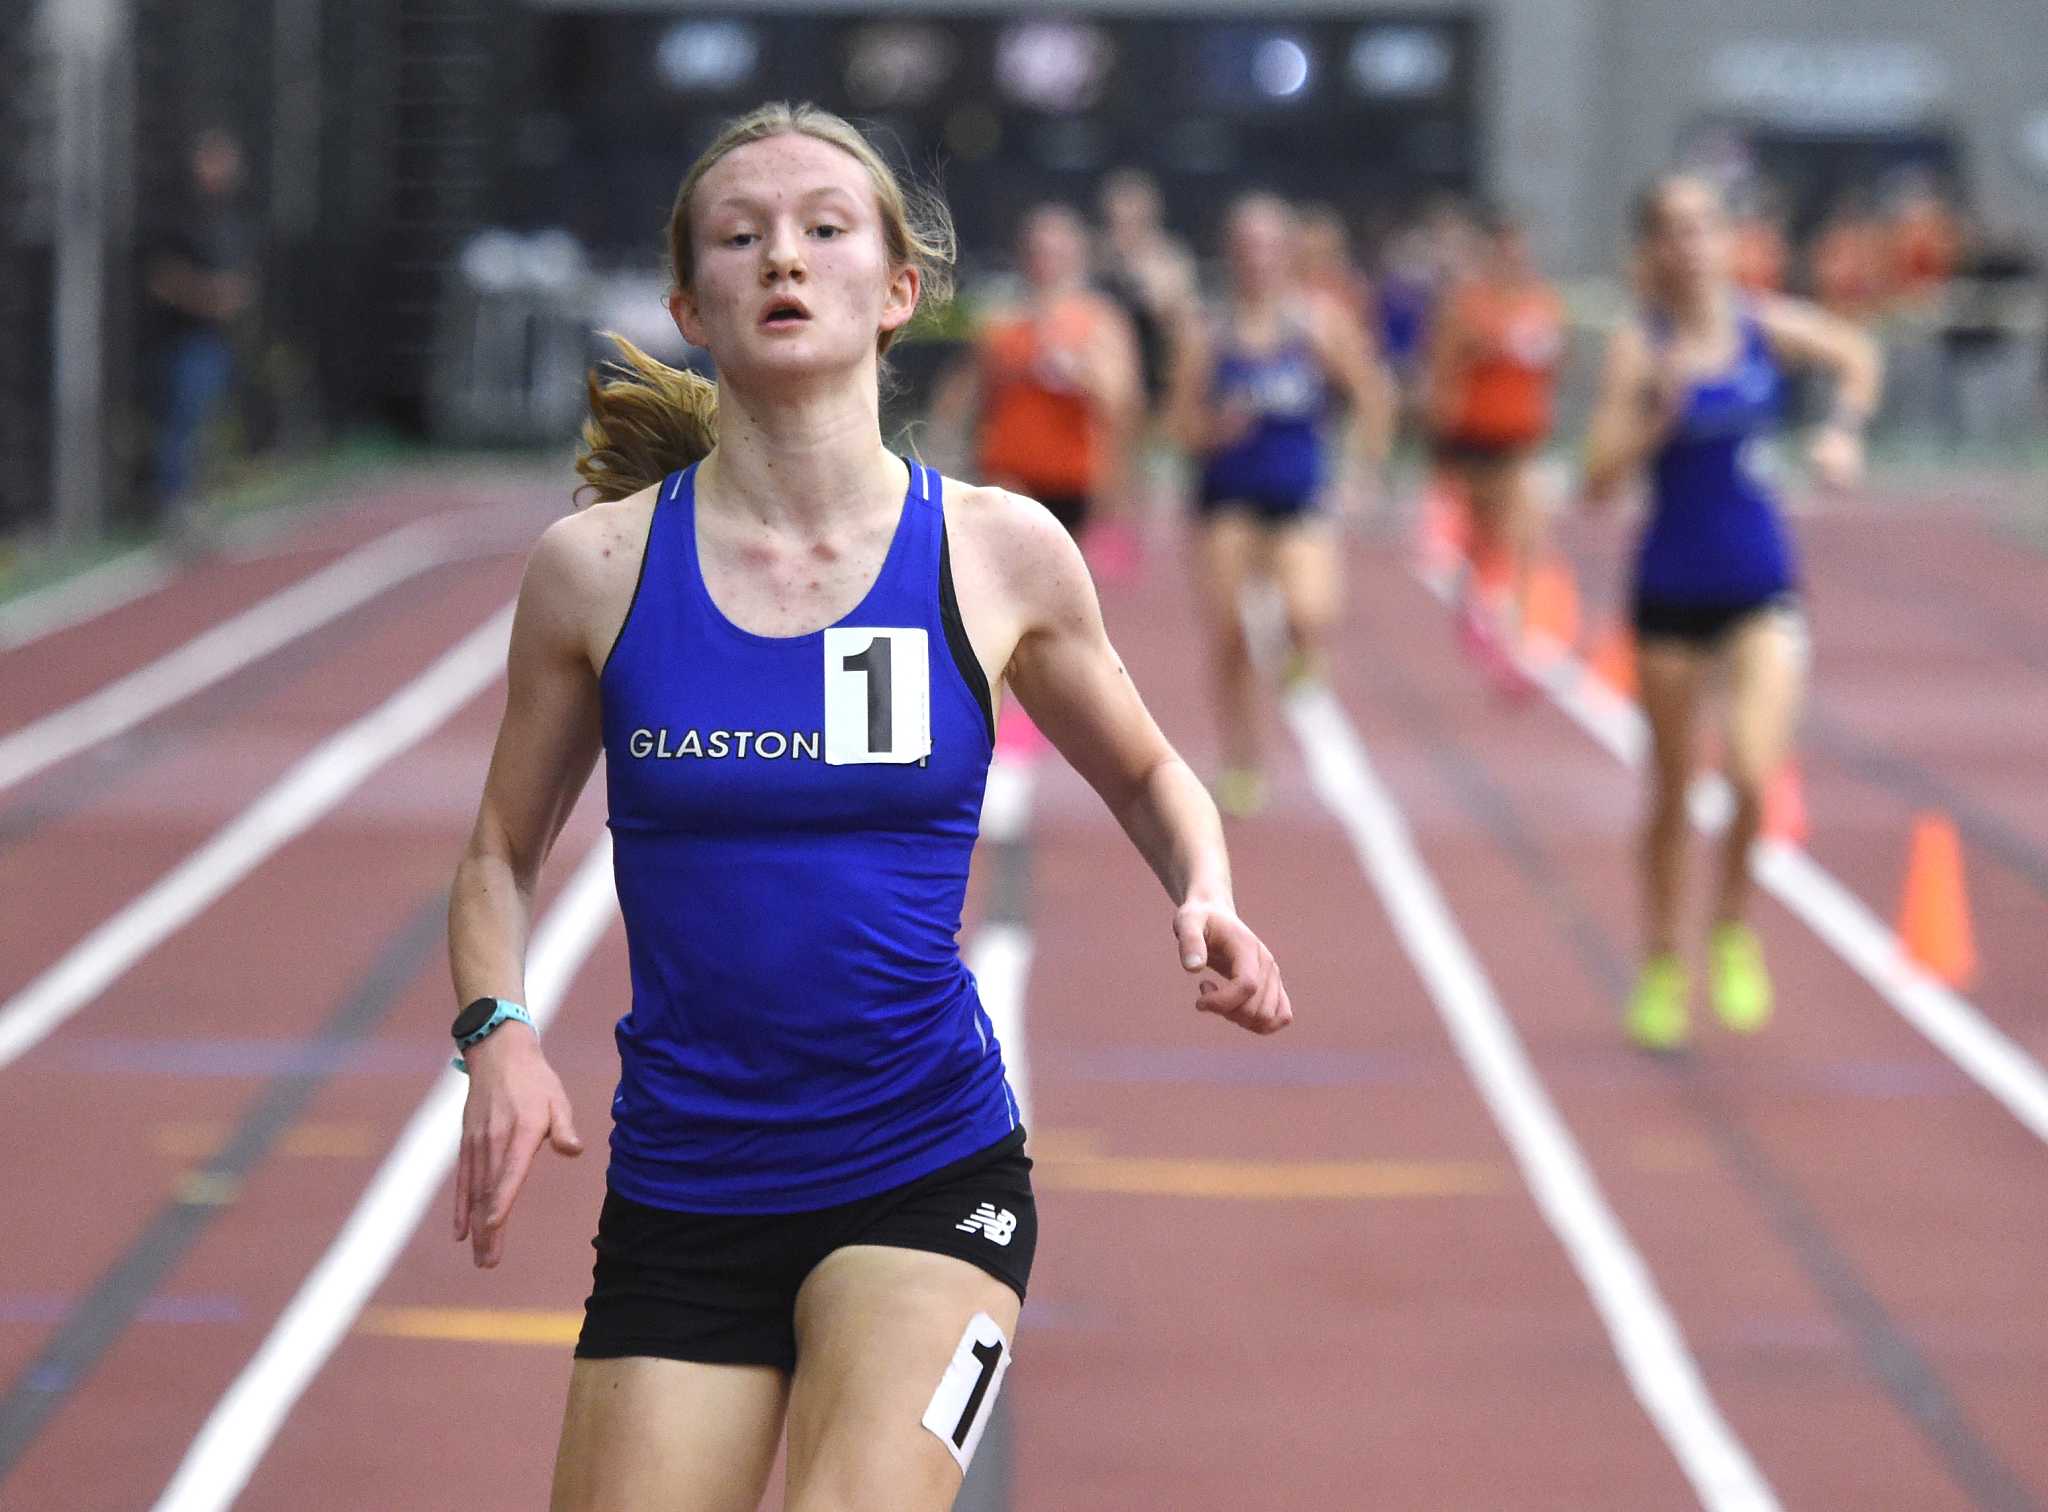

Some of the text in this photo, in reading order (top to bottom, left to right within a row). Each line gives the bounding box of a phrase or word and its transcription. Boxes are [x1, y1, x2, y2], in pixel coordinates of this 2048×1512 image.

[629, 728, 932, 767] GLASTON
[843, 636, 892, 754] 1
[951, 1339, 1003, 1451] 1
